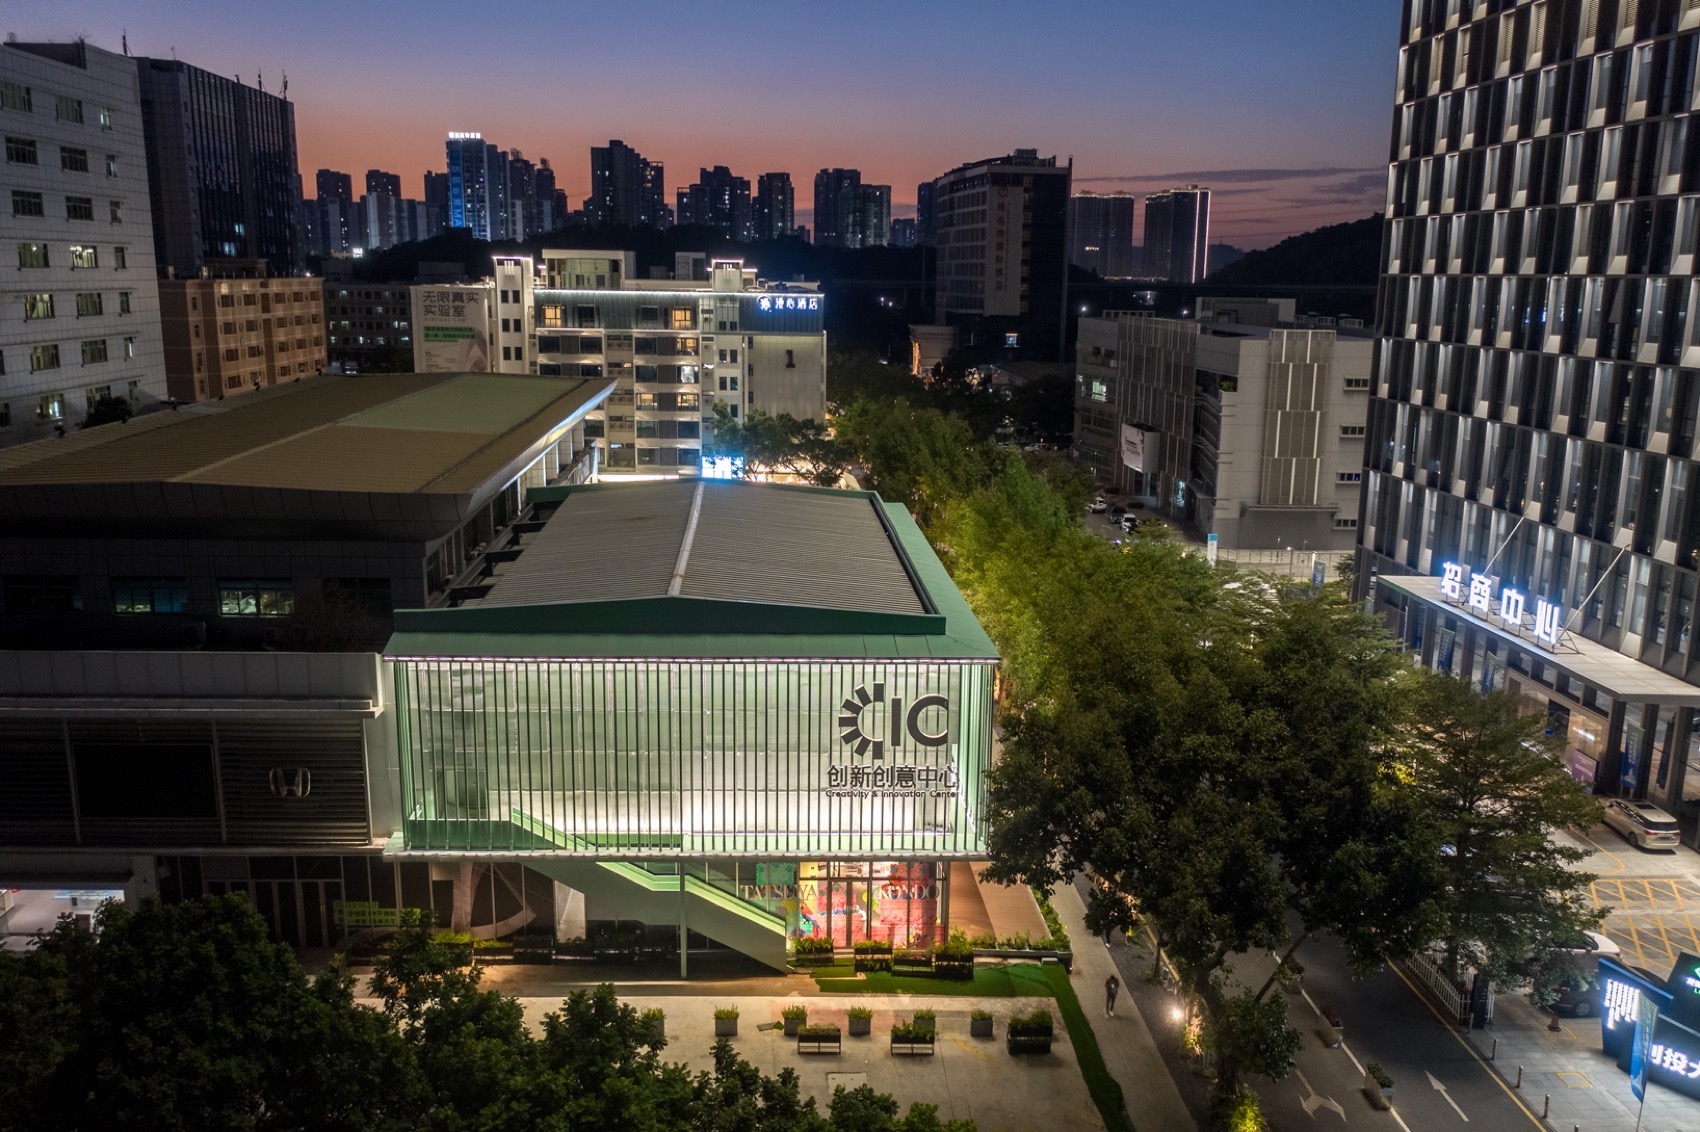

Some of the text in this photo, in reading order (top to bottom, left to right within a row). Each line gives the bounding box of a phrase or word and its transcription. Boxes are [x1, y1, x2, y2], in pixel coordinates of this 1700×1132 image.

[423, 291, 479, 304] 无限真实
[423, 304, 466, 317] 实验室
[1440, 560, 1560, 646] 招商中心
[827, 764, 960, 788] 创新创意中心
[825, 790, 869, 799] Creativity
[871, 790, 879, 798] &
[881, 790, 926, 798] Innovation
[740, 884, 941, 901] TATSUYA KONDO
